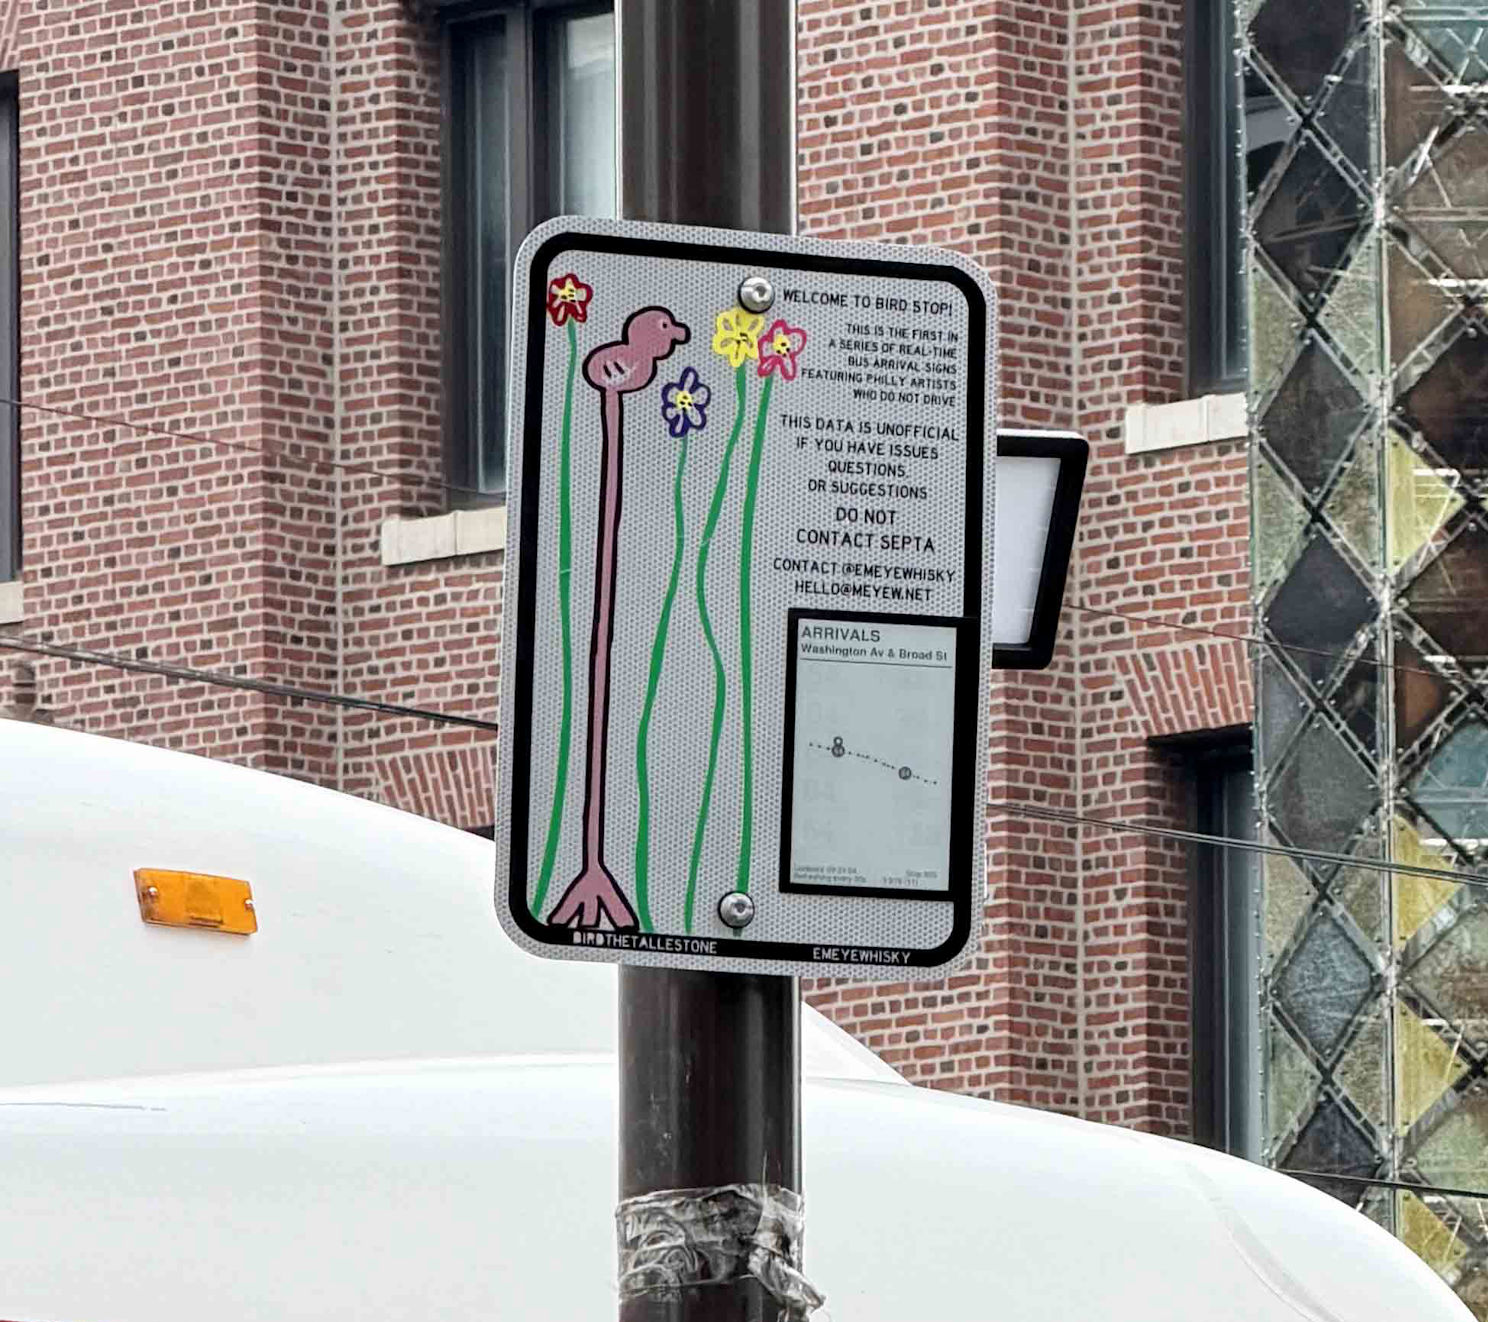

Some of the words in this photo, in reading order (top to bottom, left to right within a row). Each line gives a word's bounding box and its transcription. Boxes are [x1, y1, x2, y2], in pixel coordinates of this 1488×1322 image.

[783, 289, 848, 308] WELCOME
[854, 295, 870, 309] TO
[876, 297, 908, 312] BIRD
[913, 300, 952, 316] STOP!
[847, 323, 870, 335] THIS
[874, 325, 884, 336] IS
[889, 327, 908, 338] THE
[912, 329, 942, 341] FIRST
[947, 331, 958, 342] IN
[829, 338, 836, 348] A
[840, 339, 878, 352] SERIES
[882, 342, 894, 353] OF
[899, 344, 957, 359] REAL-TIME
[848, 356, 869, 367] BUS
[873, 358, 919, 371] ARRIVAL
[925, 362, 957, 375] SIGNS
[801, 368, 863, 384] FEATURING
[866, 373, 906, 386] PHILLY
[910, 376, 957, 390] ARTISTS
[853, 389, 877, 401] WHO
[880, 390, 895, 401] DO
[898, 392, 919, 404] NOT
[923, 394, 956, 408] DRIVE
[781, 414, 811, 429] THIS
[815, 417, 854, 433] DATA
[859, 421, 872, 434] IS
[876, 422, 959, 442] UNOFFICIAL
[797, 437, 808, 450] IF
[815, 438, 843, 452] YOU
[847, 441, 885, 456] HAVE
[890, 443, 939, 460] ISSUES
[828, 460, 906, 478] QUESTIONS
[808, 479, 826, 492] OR
[831, 481, 928, 500] SUGGESTIONS
[836, 507, 858, 523] DO
[864, 509, 897, 525] NOT
[796, 528, 874, 549] CONTACT
[880, 535, 935, 552] SEPTA
[773, 557, 837, 576] CONTACT
[842, 562, 956, 583] @EMEYEWHISKY
[795, 580, 933, 601] HELLO@MEYEW.NET
[801, 626, 880, 643] ARRIVALS
[801, 643, 867, 657] Washington
[870, 646, 884, 657] Av
[887, 648, 895, 658] &
[899, 648, 933, 660] Broad
[936, 650, 947, 661] St
[812, 947, 911, 964] EMEYEWHISKY
